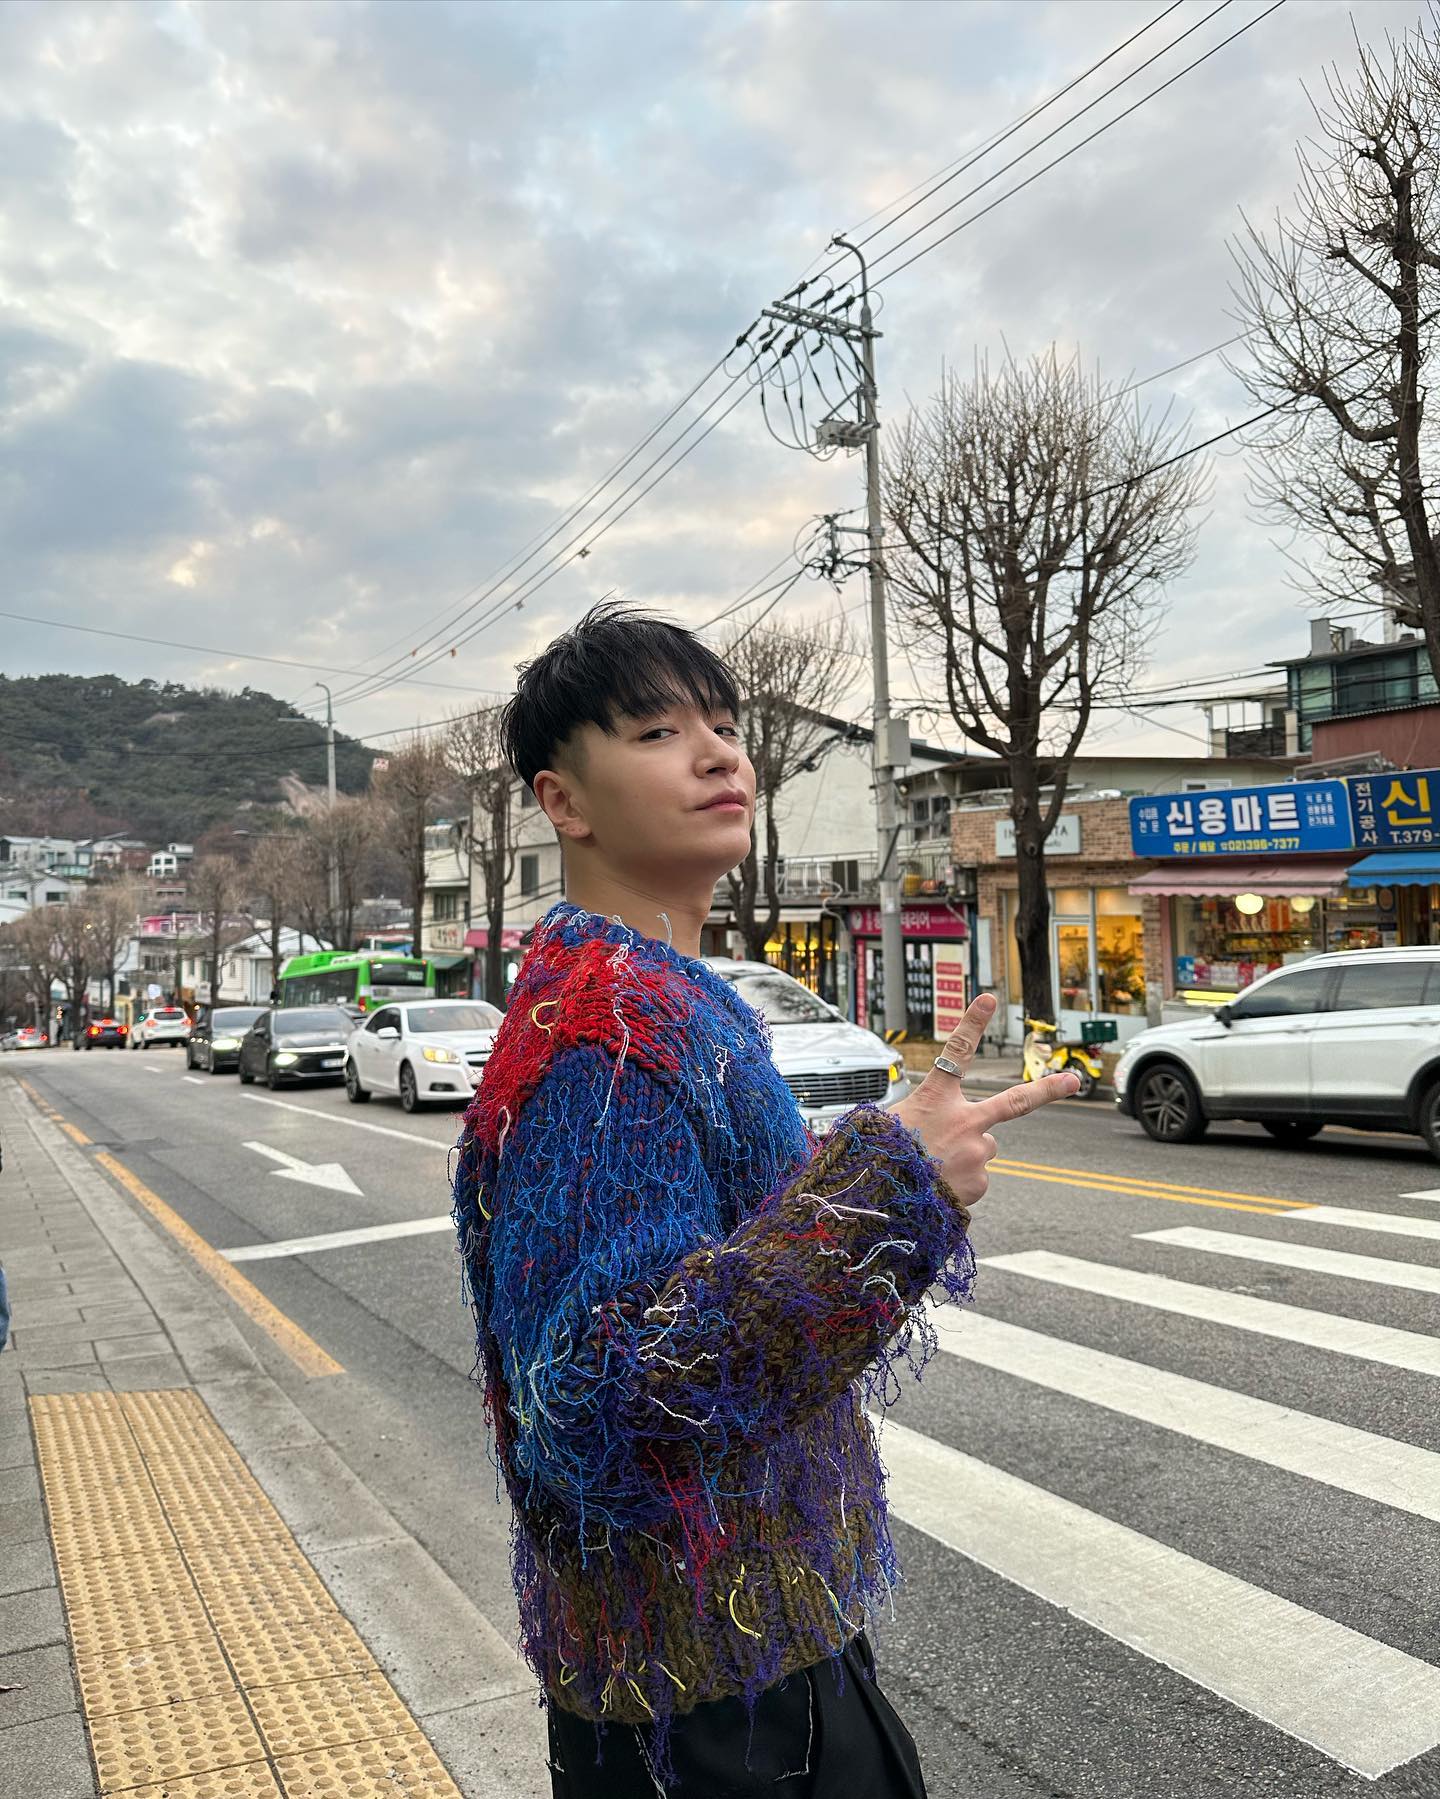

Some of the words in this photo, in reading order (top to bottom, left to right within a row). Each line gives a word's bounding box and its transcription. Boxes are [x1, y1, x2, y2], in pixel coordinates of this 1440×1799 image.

[1166, 793, 1300, 836] 신용마트
[1355, 782, 1378, 845] 전기공사
[1381, 777, 1432, 826] 신
